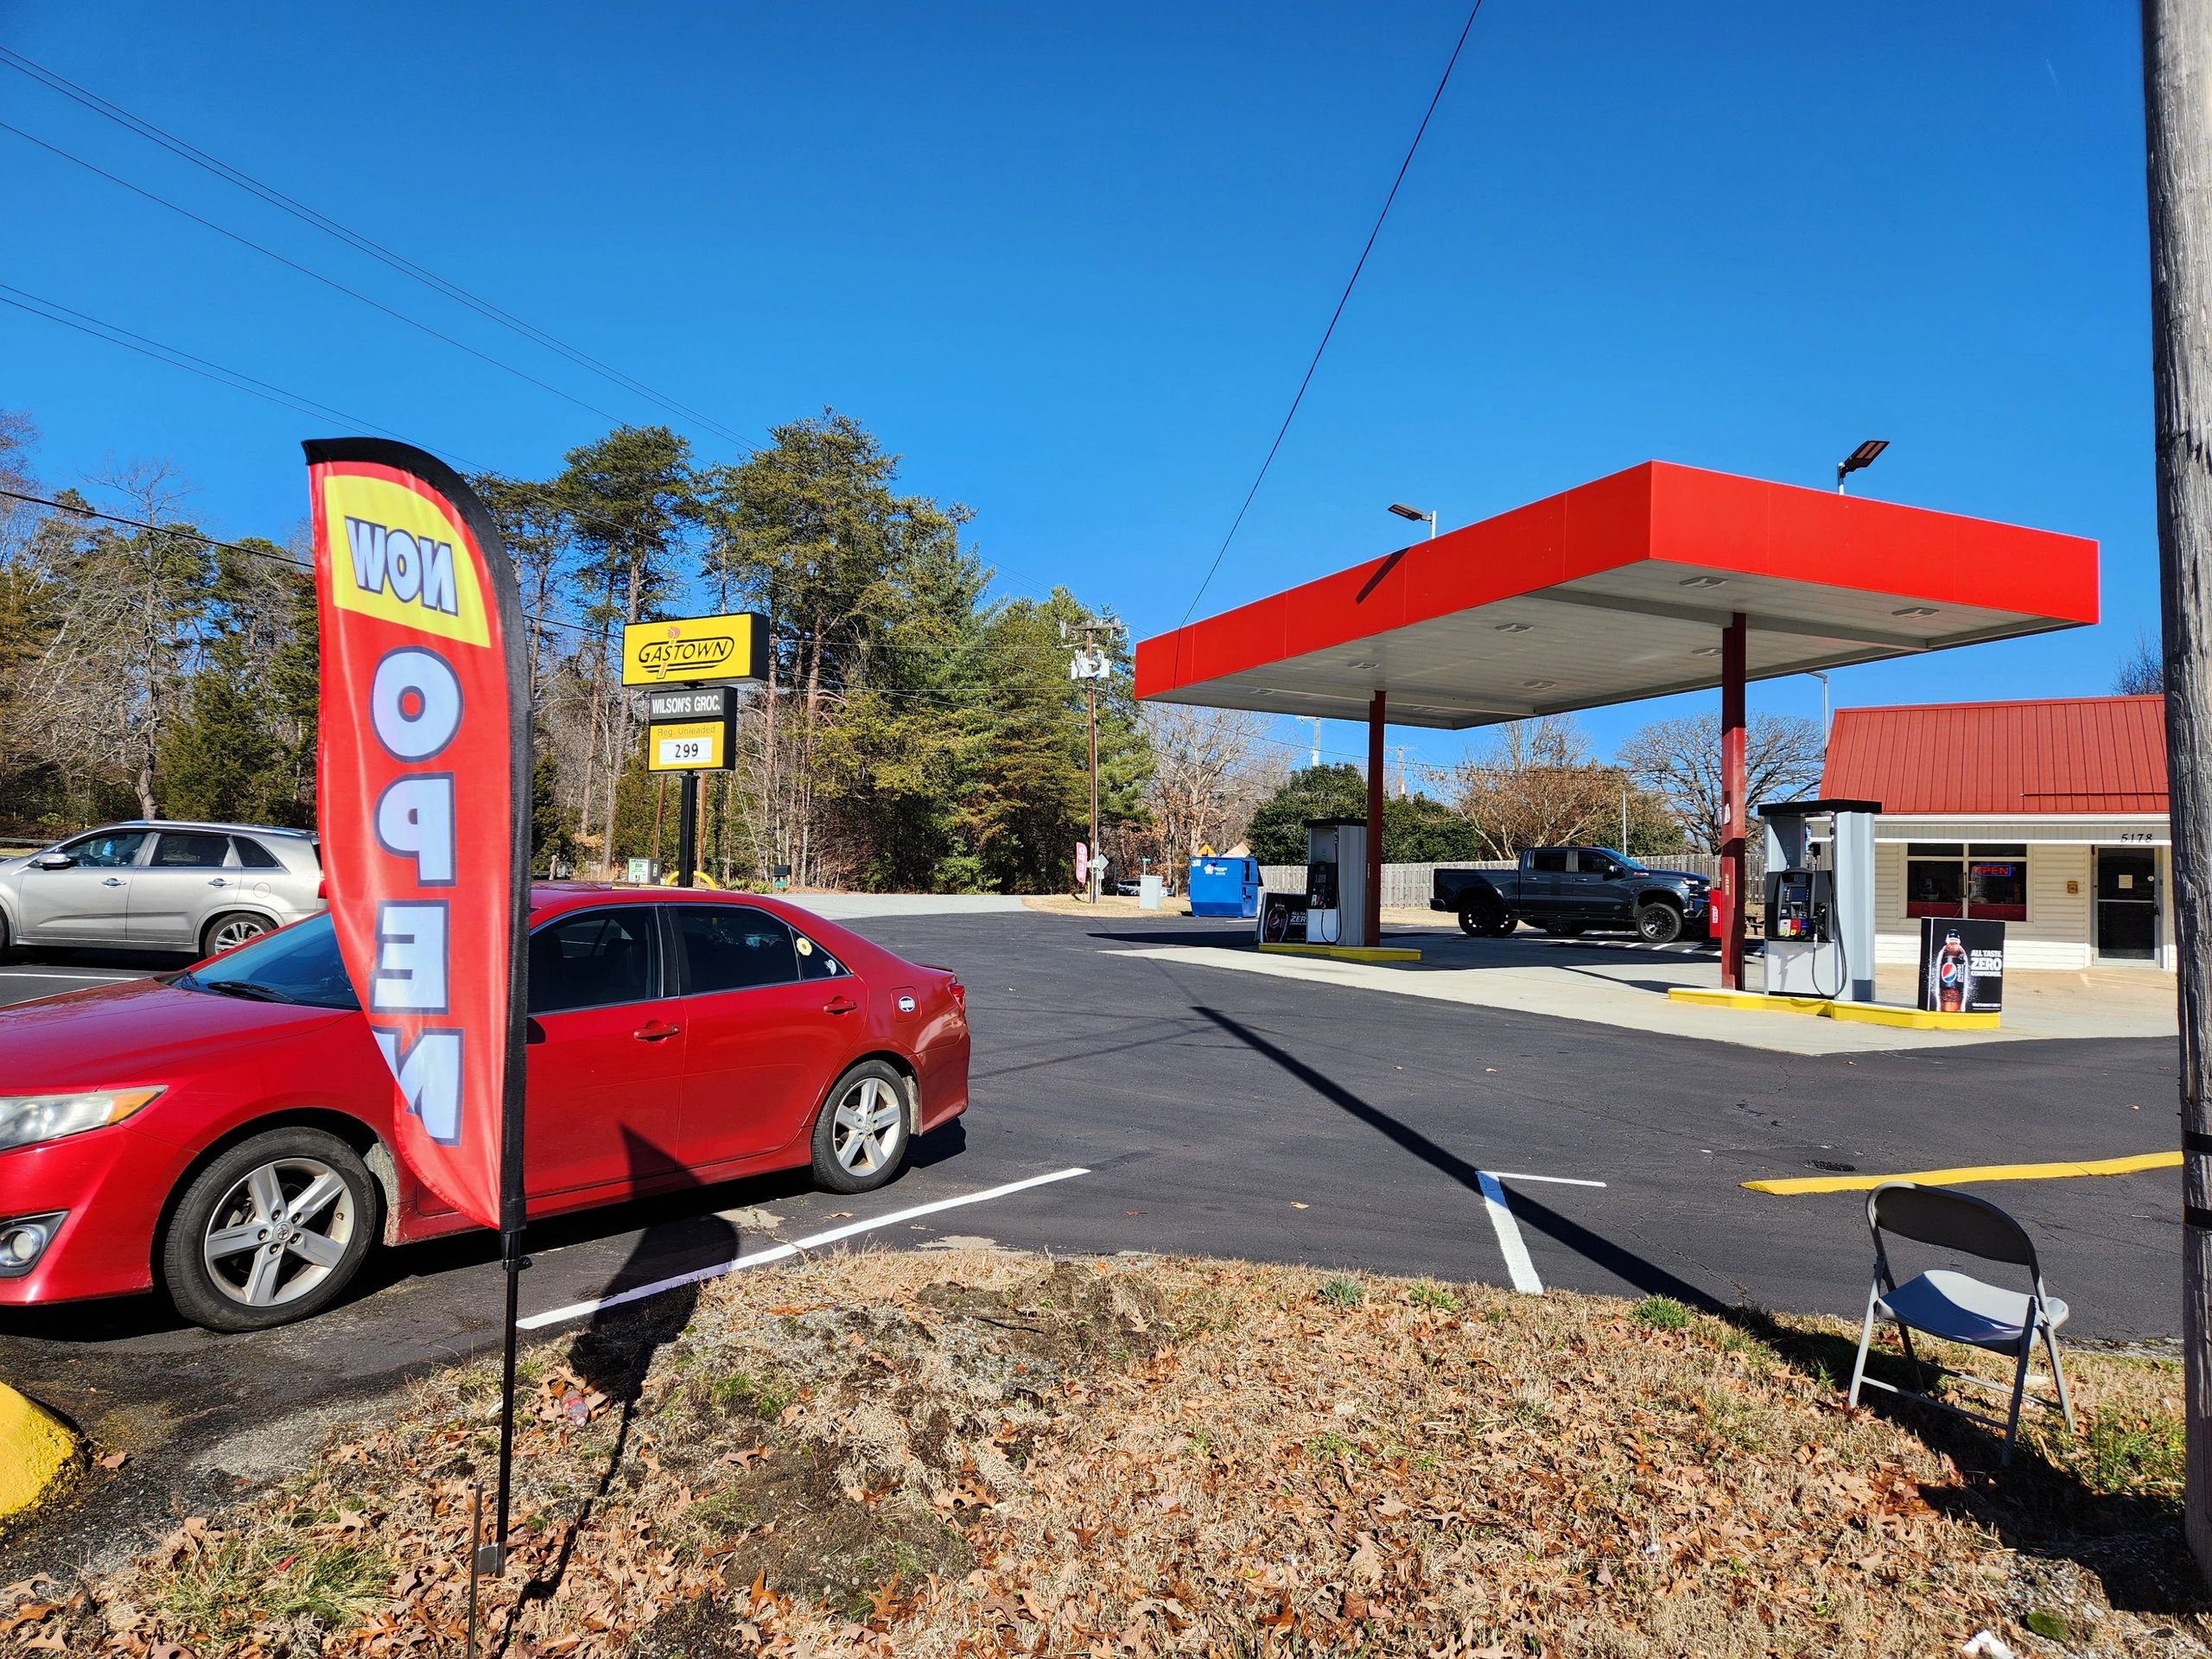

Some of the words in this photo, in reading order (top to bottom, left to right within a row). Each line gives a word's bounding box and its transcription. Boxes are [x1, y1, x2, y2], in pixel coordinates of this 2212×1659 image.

[639, 640, 729, 663] GASTOWN
[652, 697, 691, 714] WILSON'S
[694, 695, 721, 711] GROC.
[658, 728, 675, 737] Reg.
[678, 725, 716, 735] Unleaded
[675, 743, 699, 758] 299
[2121, 833, 2152, 843] 5178
[1972, 866, 2008, 875] OPEN
[1970, 957, 2003, 971] ZERO
